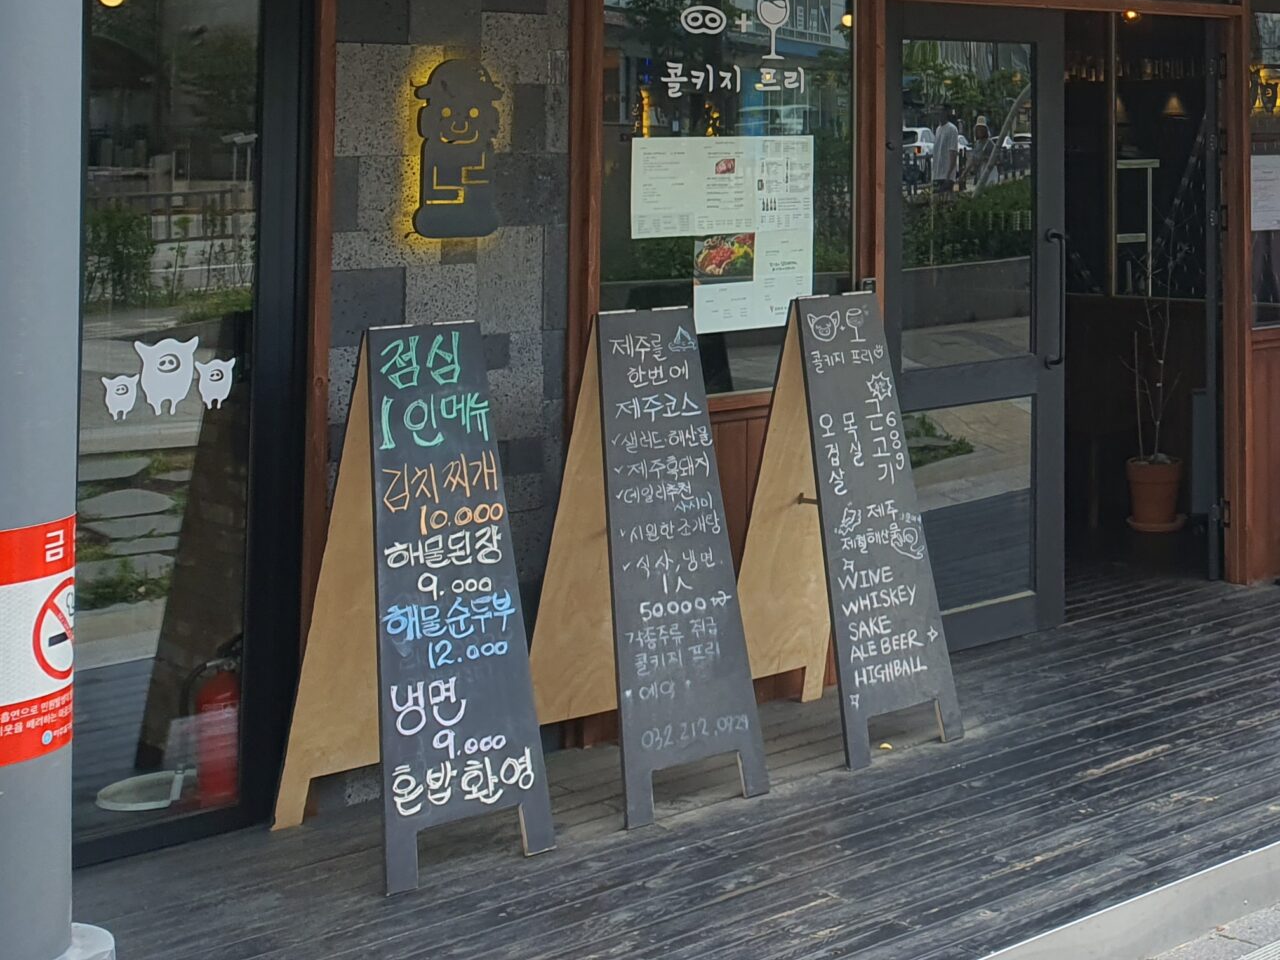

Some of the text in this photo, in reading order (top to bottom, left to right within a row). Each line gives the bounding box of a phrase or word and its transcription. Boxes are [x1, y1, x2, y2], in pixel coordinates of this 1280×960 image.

[660, 61, 805, 98] 콜키지 프리
[380, 331, 460, 389] 점심
[609, 333, 667, 363] 제주를
[811, 349, 873, 373] 콜키지 프리
[615, 392, 702, 422] 제주코스
[382, 450, 498, 513] 김치찌개
[866, 499, 898, 521] 제주
[630, 509, 721, 543] 시원한 조개탕
[384, 524, 502, 569] 해물된장
[417, 572, 492, 601] 9.000
[838, 566, 894, 591] WINE
[842, 584, 917, 617] WHISKEY
[849, 616, 892, 641] SAKE
[428, 640, 508, 669] 12.000
[688, 641, 720, 661] 프리
[851, 629, 924, 664] ALE BEER
[638, 681, 675, 700] 예약
[390, 676, 467, 736] 냉면
